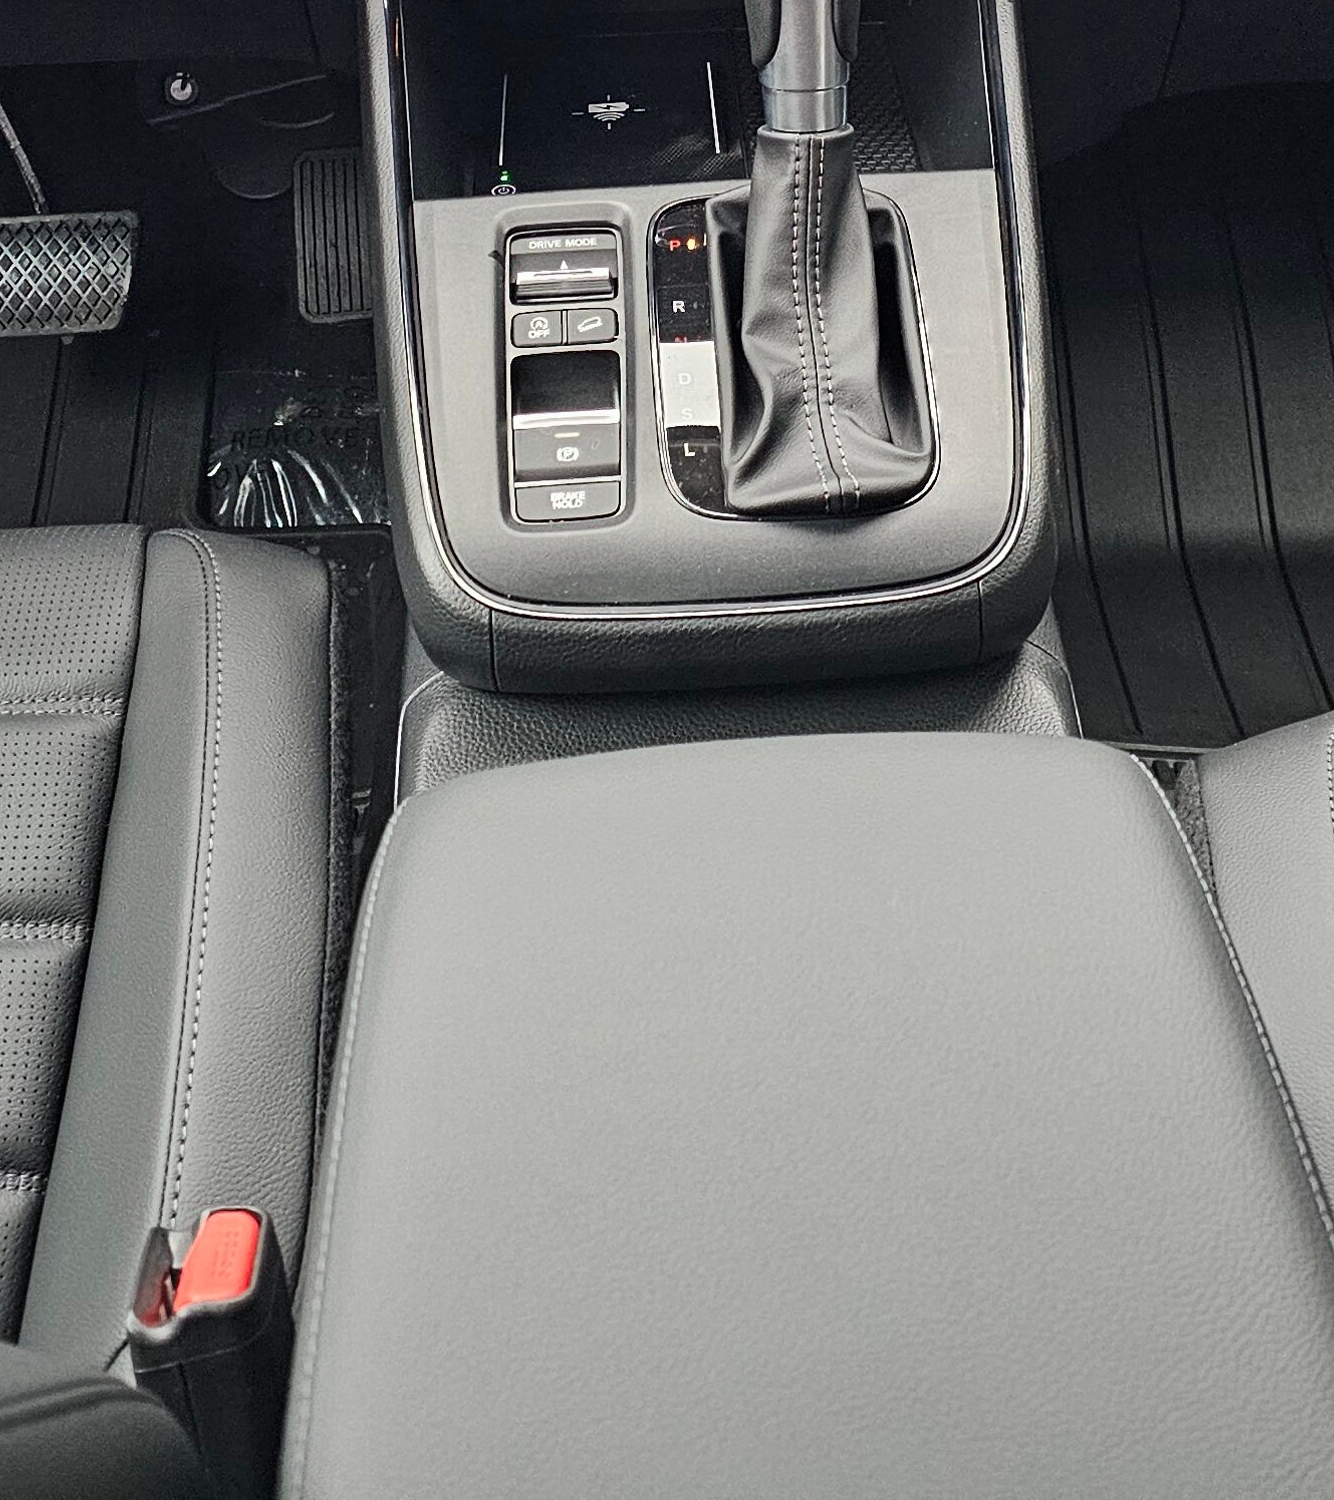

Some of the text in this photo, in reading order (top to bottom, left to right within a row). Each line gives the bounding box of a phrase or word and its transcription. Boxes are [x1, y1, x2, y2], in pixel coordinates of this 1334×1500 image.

[528, 237, 598, 250] DRIVE MODE
[669, 239, 680, 251] P
[672, 300, 686, 313] R
[528, 328, 550, 340] OFF
[678, 372, 692, 385] D
[681, 408, 694, 420] S
[684, 442, 696, 457] L
